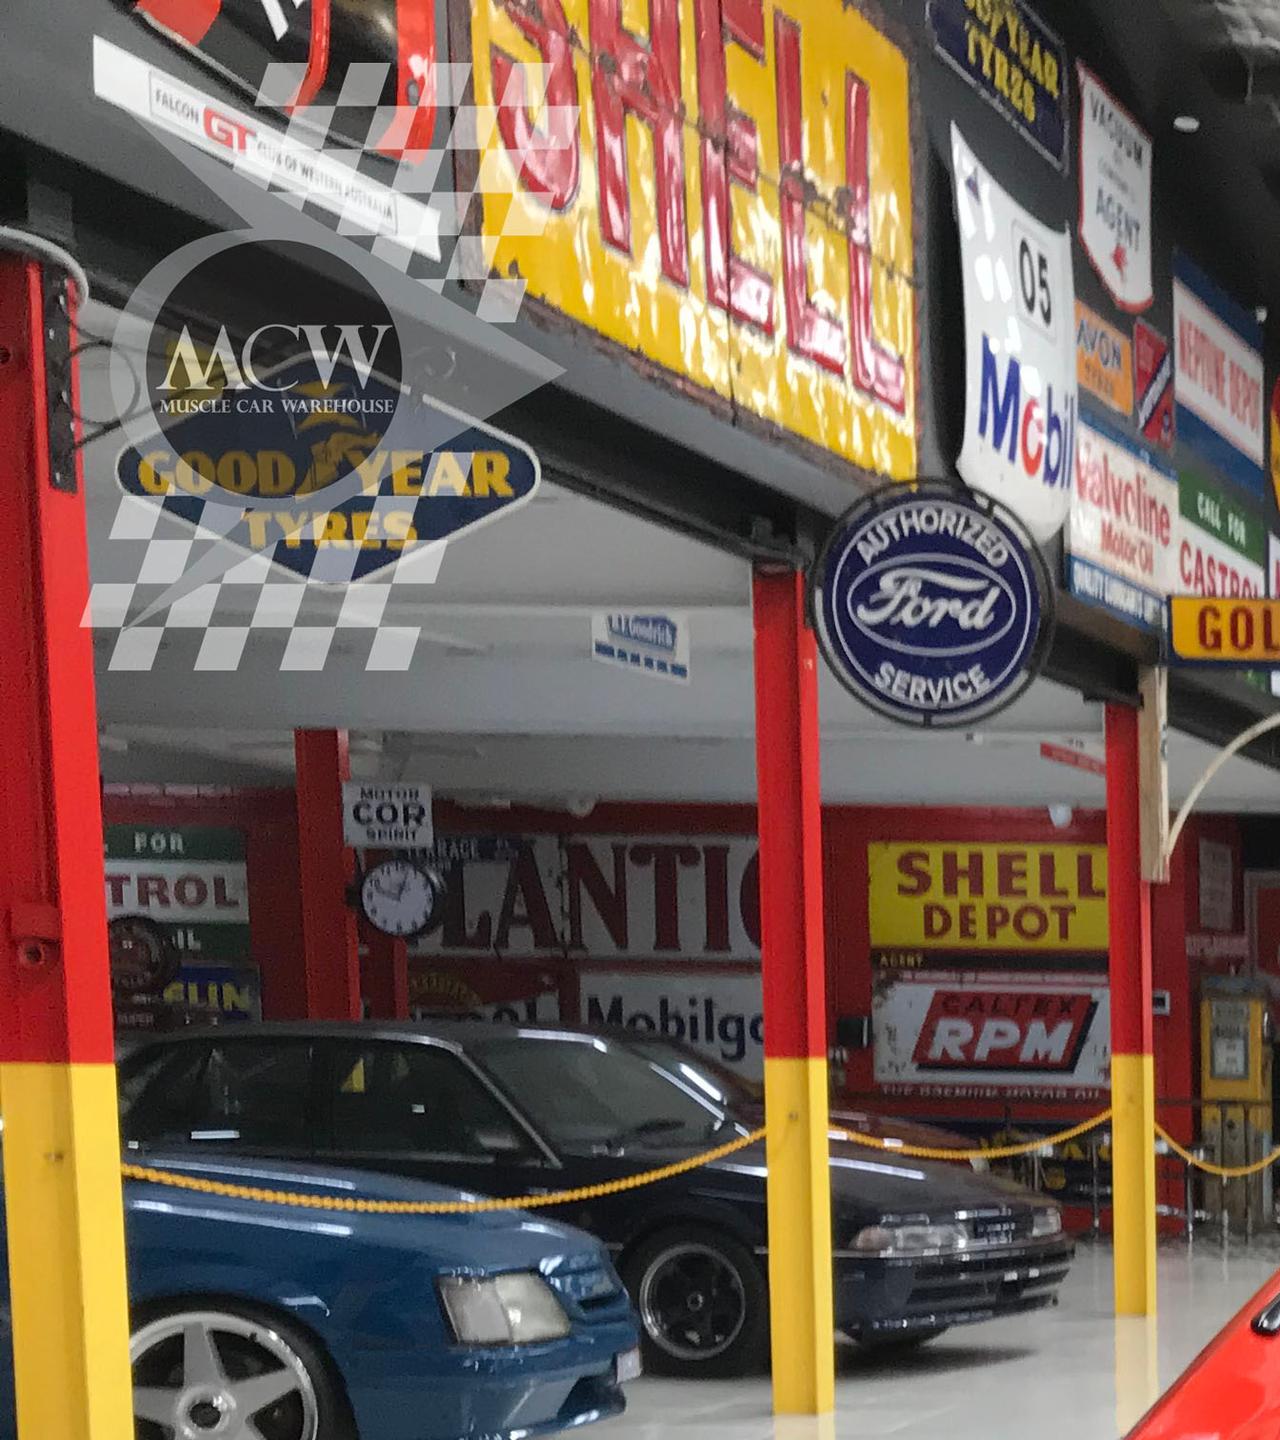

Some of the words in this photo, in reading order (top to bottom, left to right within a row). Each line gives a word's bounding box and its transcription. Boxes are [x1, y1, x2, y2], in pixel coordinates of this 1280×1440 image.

[156, 89, 199, 122] FALCON
[203, 107, 257, 154] GT
[1018, 240, 1053, 328] 05
[977, 332, 1075, 489] Mobil
[1076, 448, 1170, 547] Valvoline
[243, 511, 417, 550] TYRES
[857, 506, 1009, 567] AUTHORIZED
[857, 567, 1000, 630] Ford
[875, 661, 990, 706] SERVICE
[353, 801, 426, 826] COR
[360, 788, 419, 800] MOTOR
[134, 832, 185, 854] FOR
[366, 829, 417, 841] SPIRIT
[442, 843, 760, 951] LANTI
[897, 851, 1106, 898] SHELL
[923, 904, 1076, 941] DEPOT
[928, 1018, 1074, 1063] RPM
